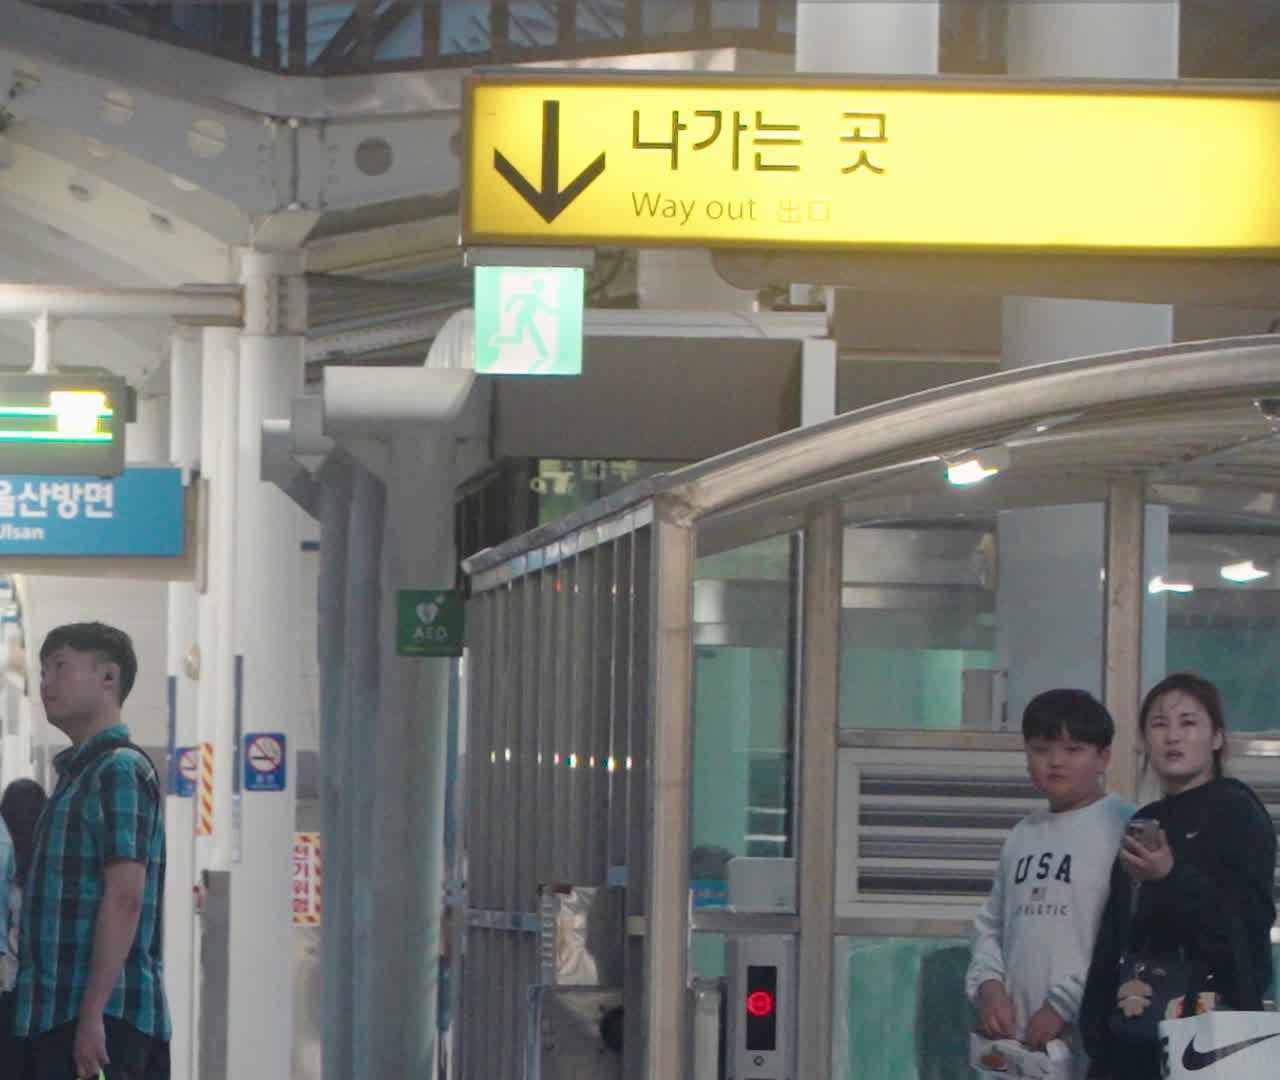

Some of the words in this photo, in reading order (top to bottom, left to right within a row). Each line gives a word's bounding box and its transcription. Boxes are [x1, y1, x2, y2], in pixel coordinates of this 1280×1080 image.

[632, 109, 802, 171] 나가는
[840, 112, 888, 175] 곳
[632, 191, 695, 225] Way
[706, 198, 757, 221] out
[778, 199, 831, 223] 出口
[412, 626, 449, 641] AED
[1015, 852, 1072, 884] USA
